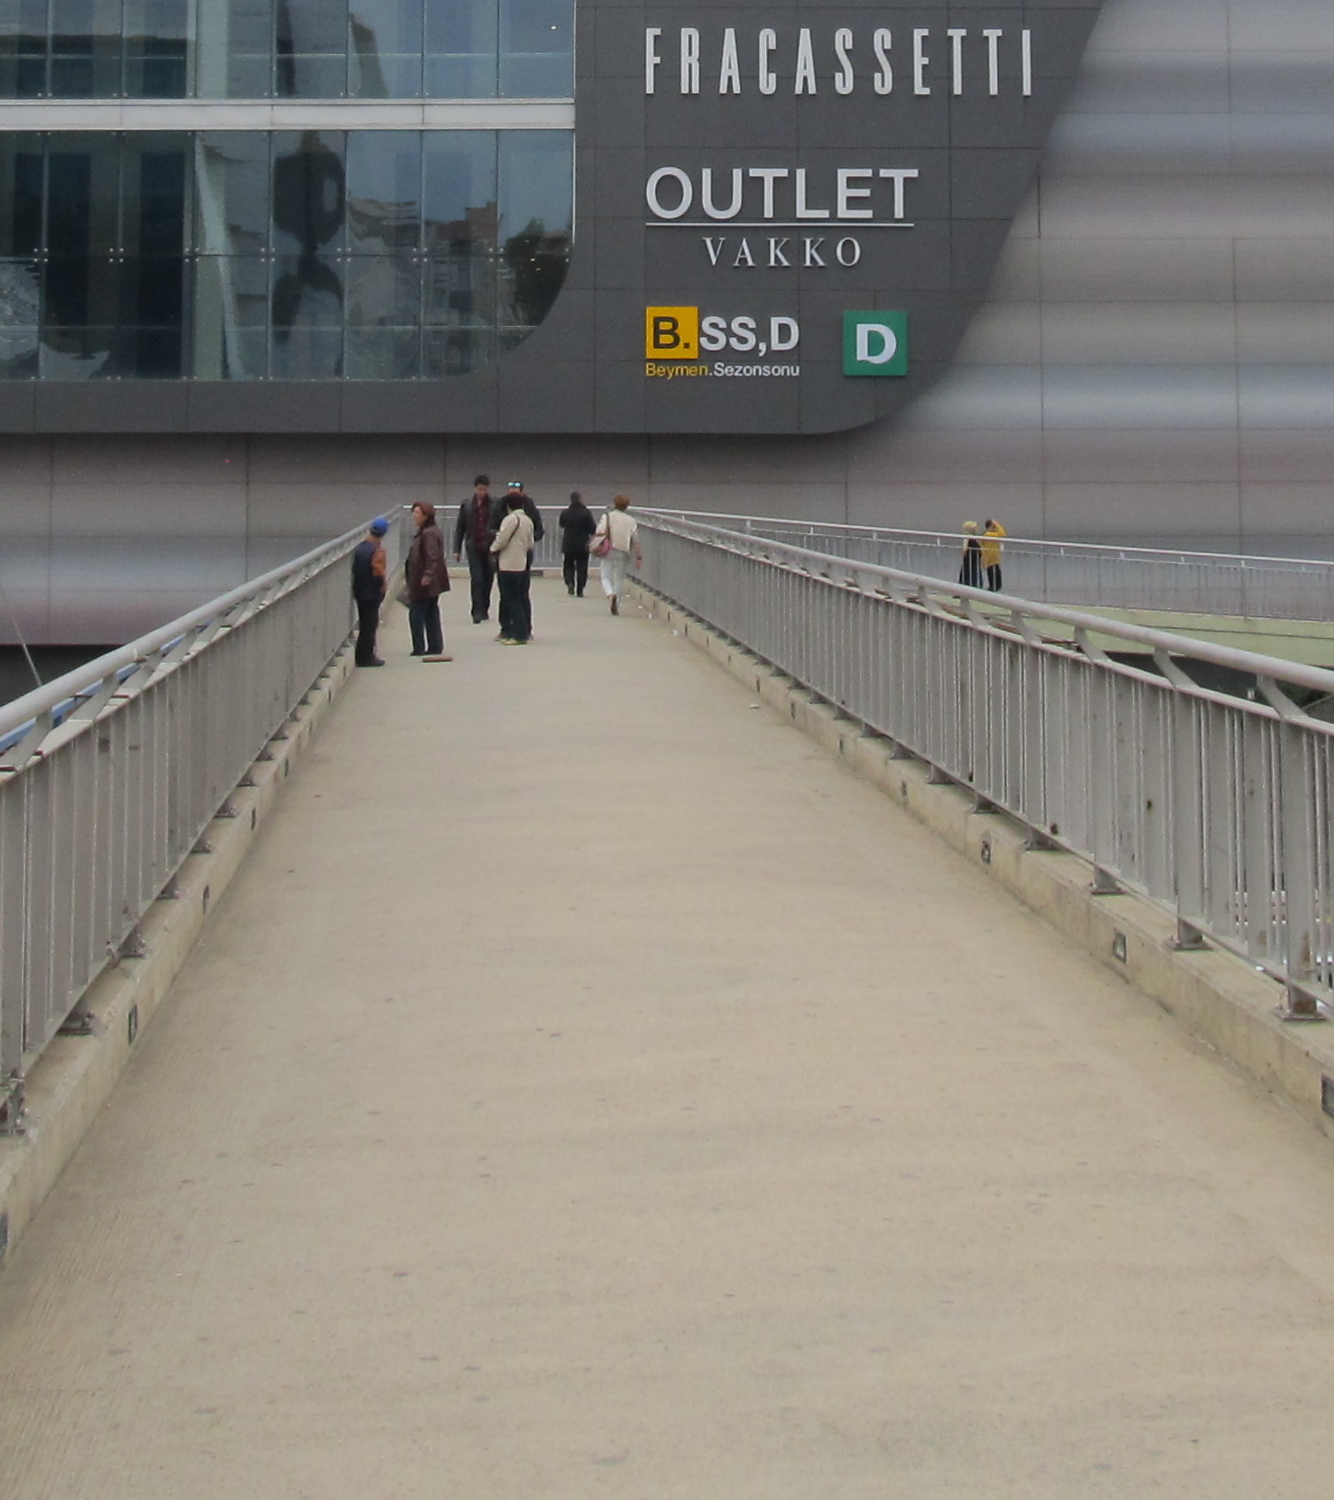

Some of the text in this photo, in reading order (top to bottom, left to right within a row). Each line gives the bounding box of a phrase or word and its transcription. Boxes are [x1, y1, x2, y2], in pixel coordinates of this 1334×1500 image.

[644, 27, 1032, 97] FRACASSETTI
[645, 166, 919, 220] OUTLET
[703, 237, 862, 267] VAKKO
